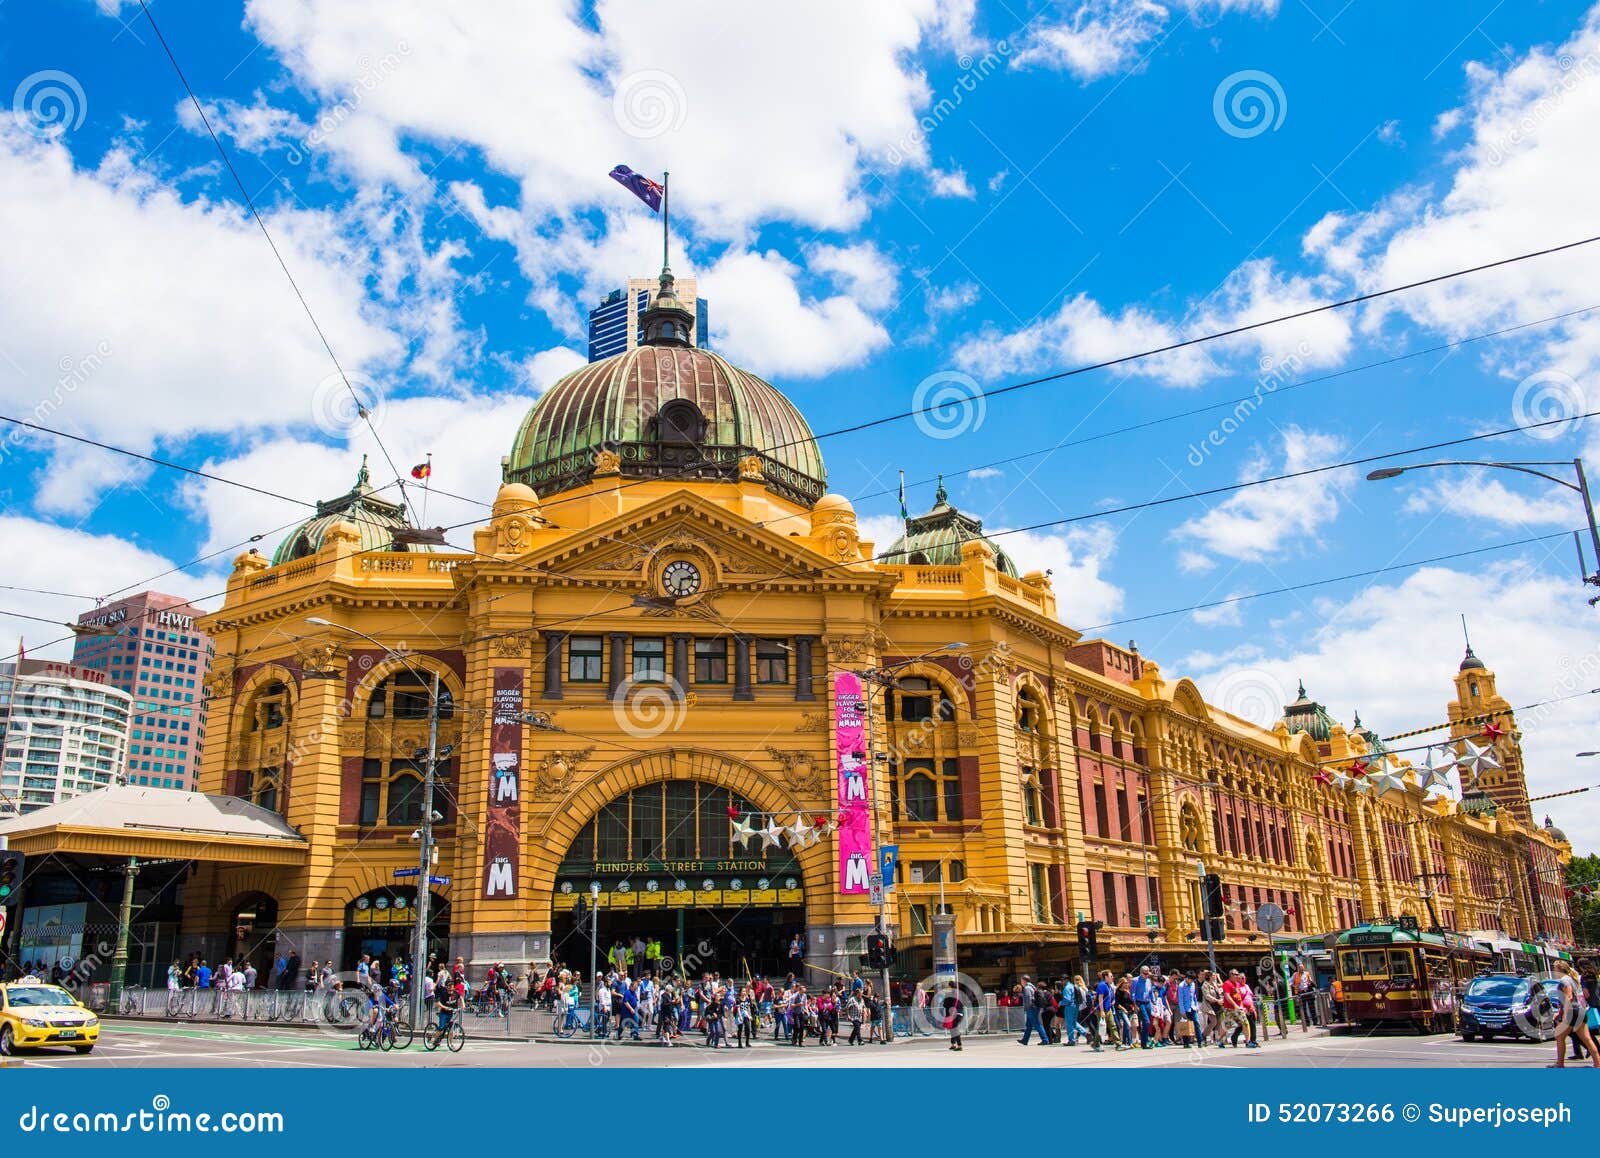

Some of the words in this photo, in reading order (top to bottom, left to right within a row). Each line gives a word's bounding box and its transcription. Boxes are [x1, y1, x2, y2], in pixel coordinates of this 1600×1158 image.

[159, 610, 193, 628] HWT
[595, 863, 649, 873] FLINDERS
[664, 862, 704, 872] STREET
[717, 861, 767, 871] STATION
[486, 863, 514, 896] M
